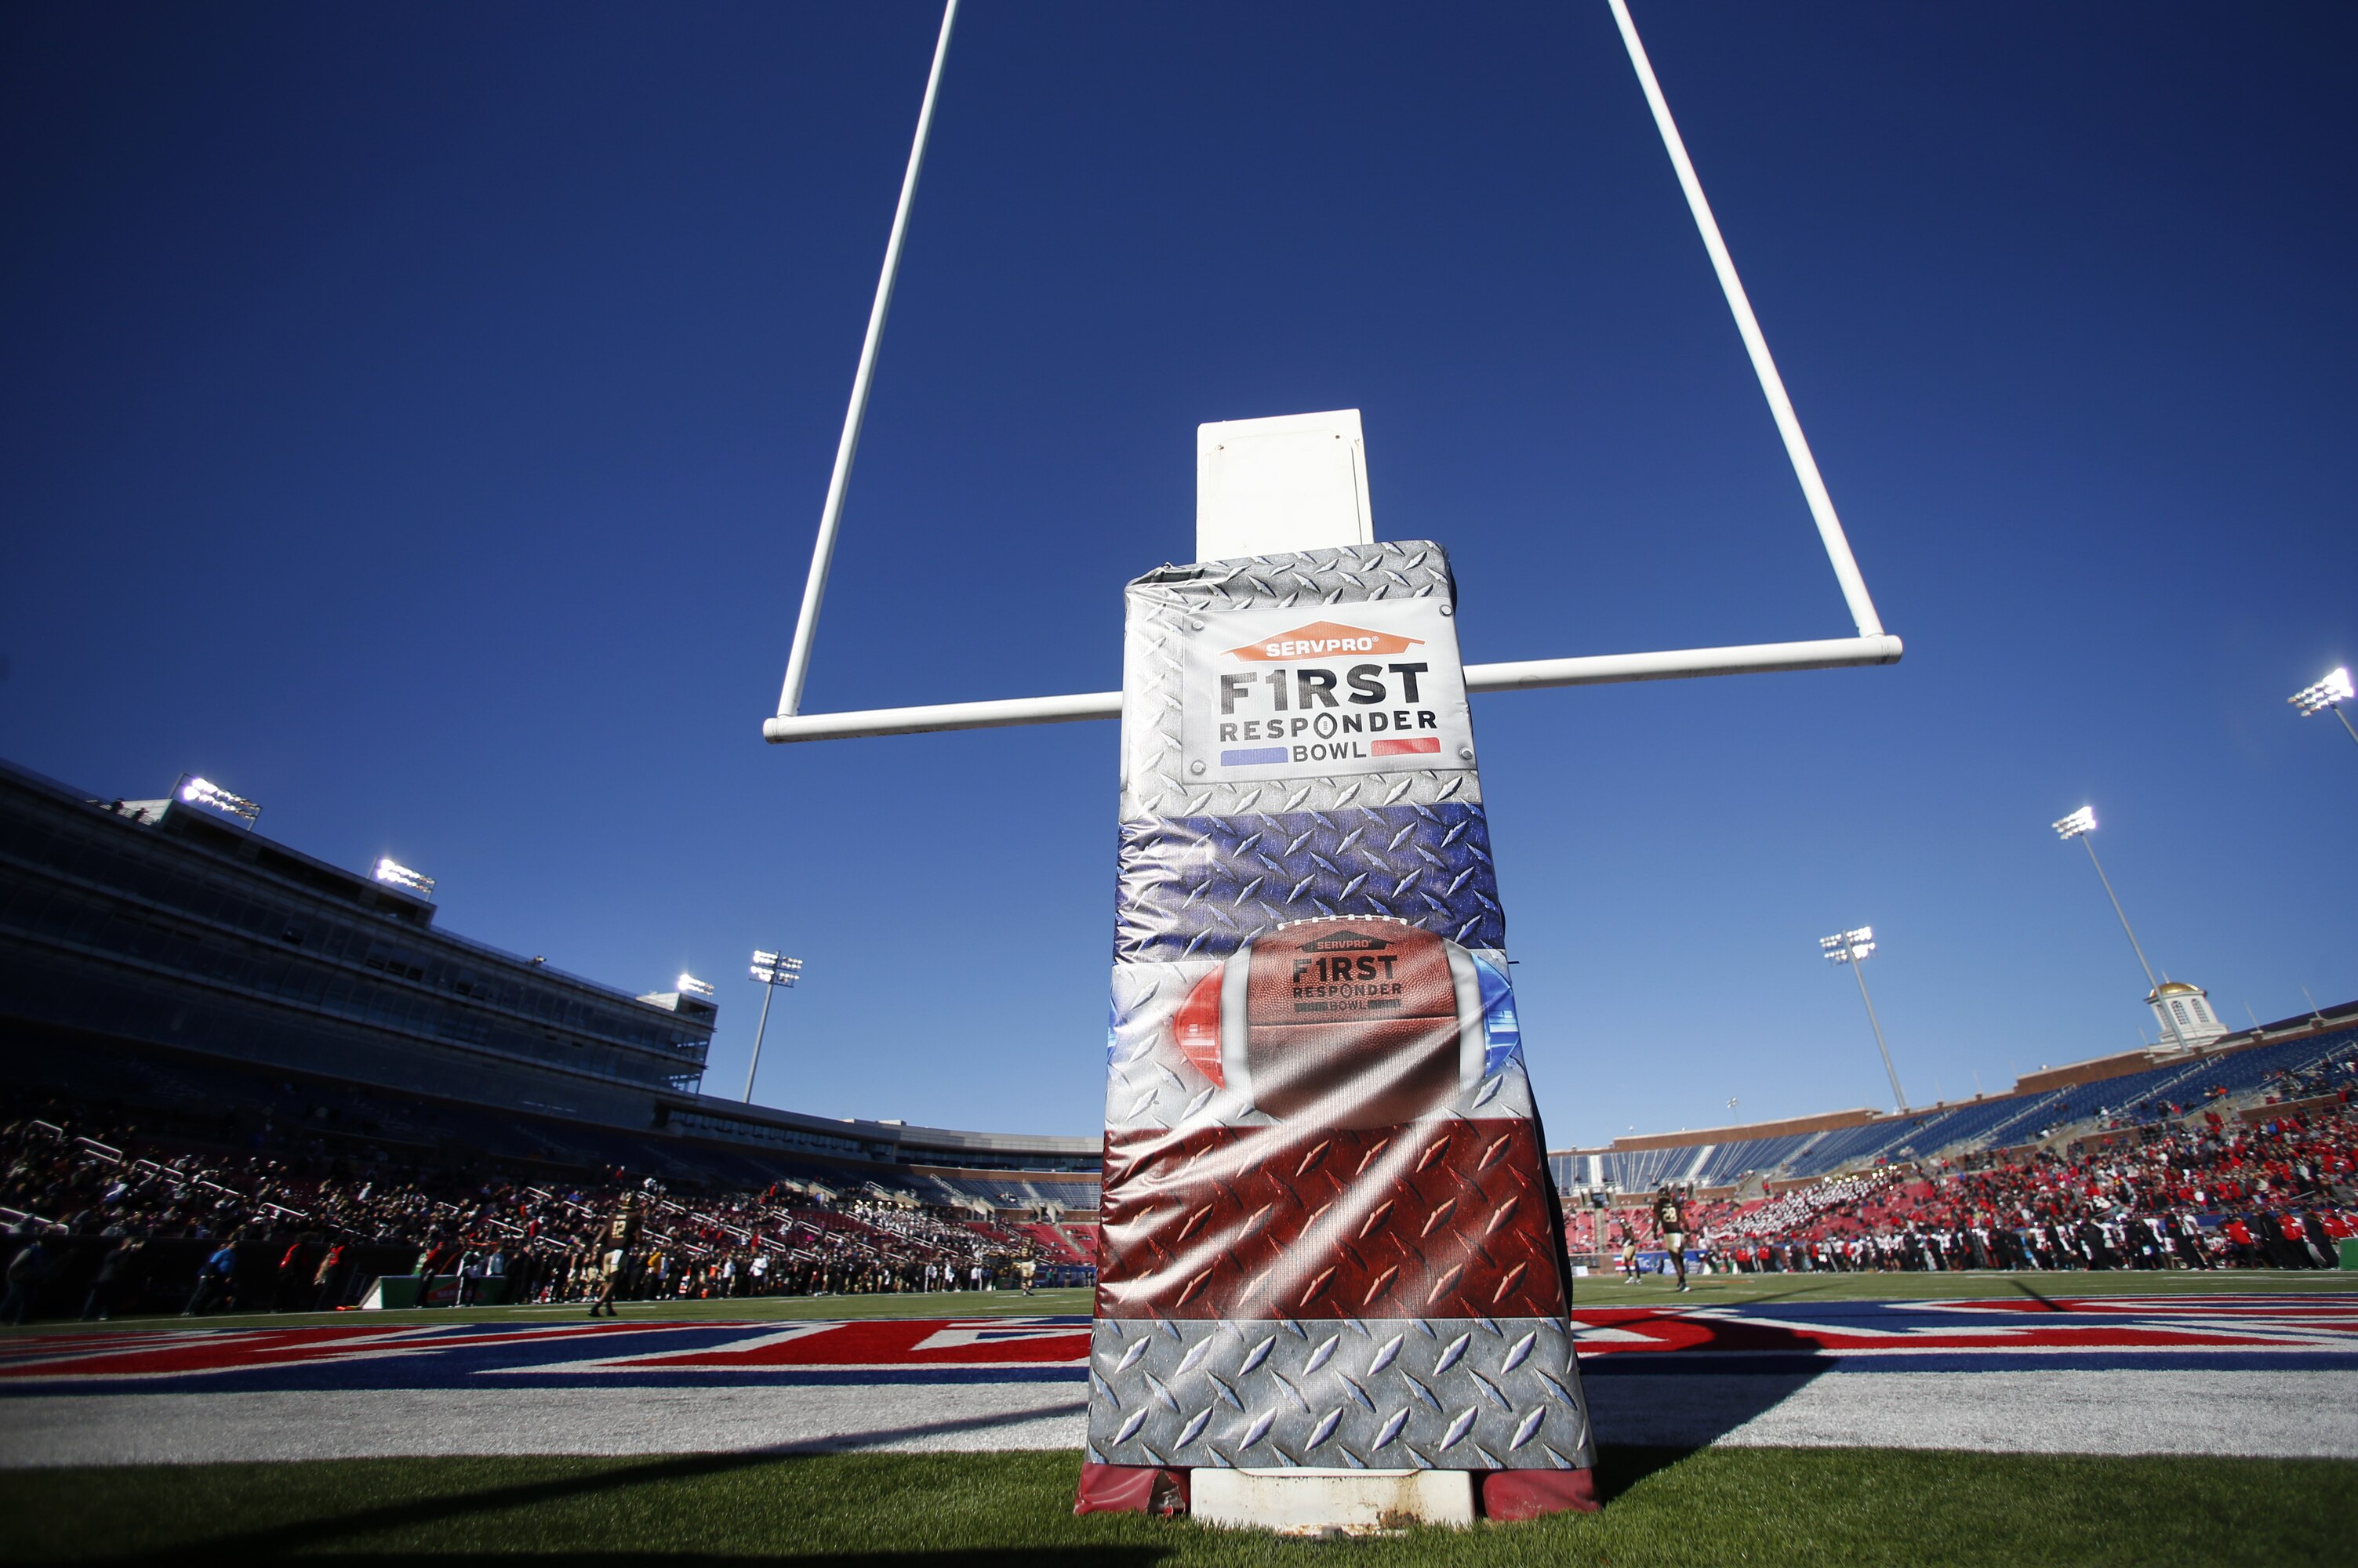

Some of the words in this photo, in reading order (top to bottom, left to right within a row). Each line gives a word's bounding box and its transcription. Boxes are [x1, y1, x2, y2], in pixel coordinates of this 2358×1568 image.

[1220, 662, 1429, 715] F1RST
[1219, 710, 1437, 742] RESPONDER
[1293, 742, 1367, 763] BOWL
[1293, 955, 1397, 982] F1RST
[1293, 983, 1401, 998] RESPONDER
[1330, 1000, 1366, 1011] BOWL
